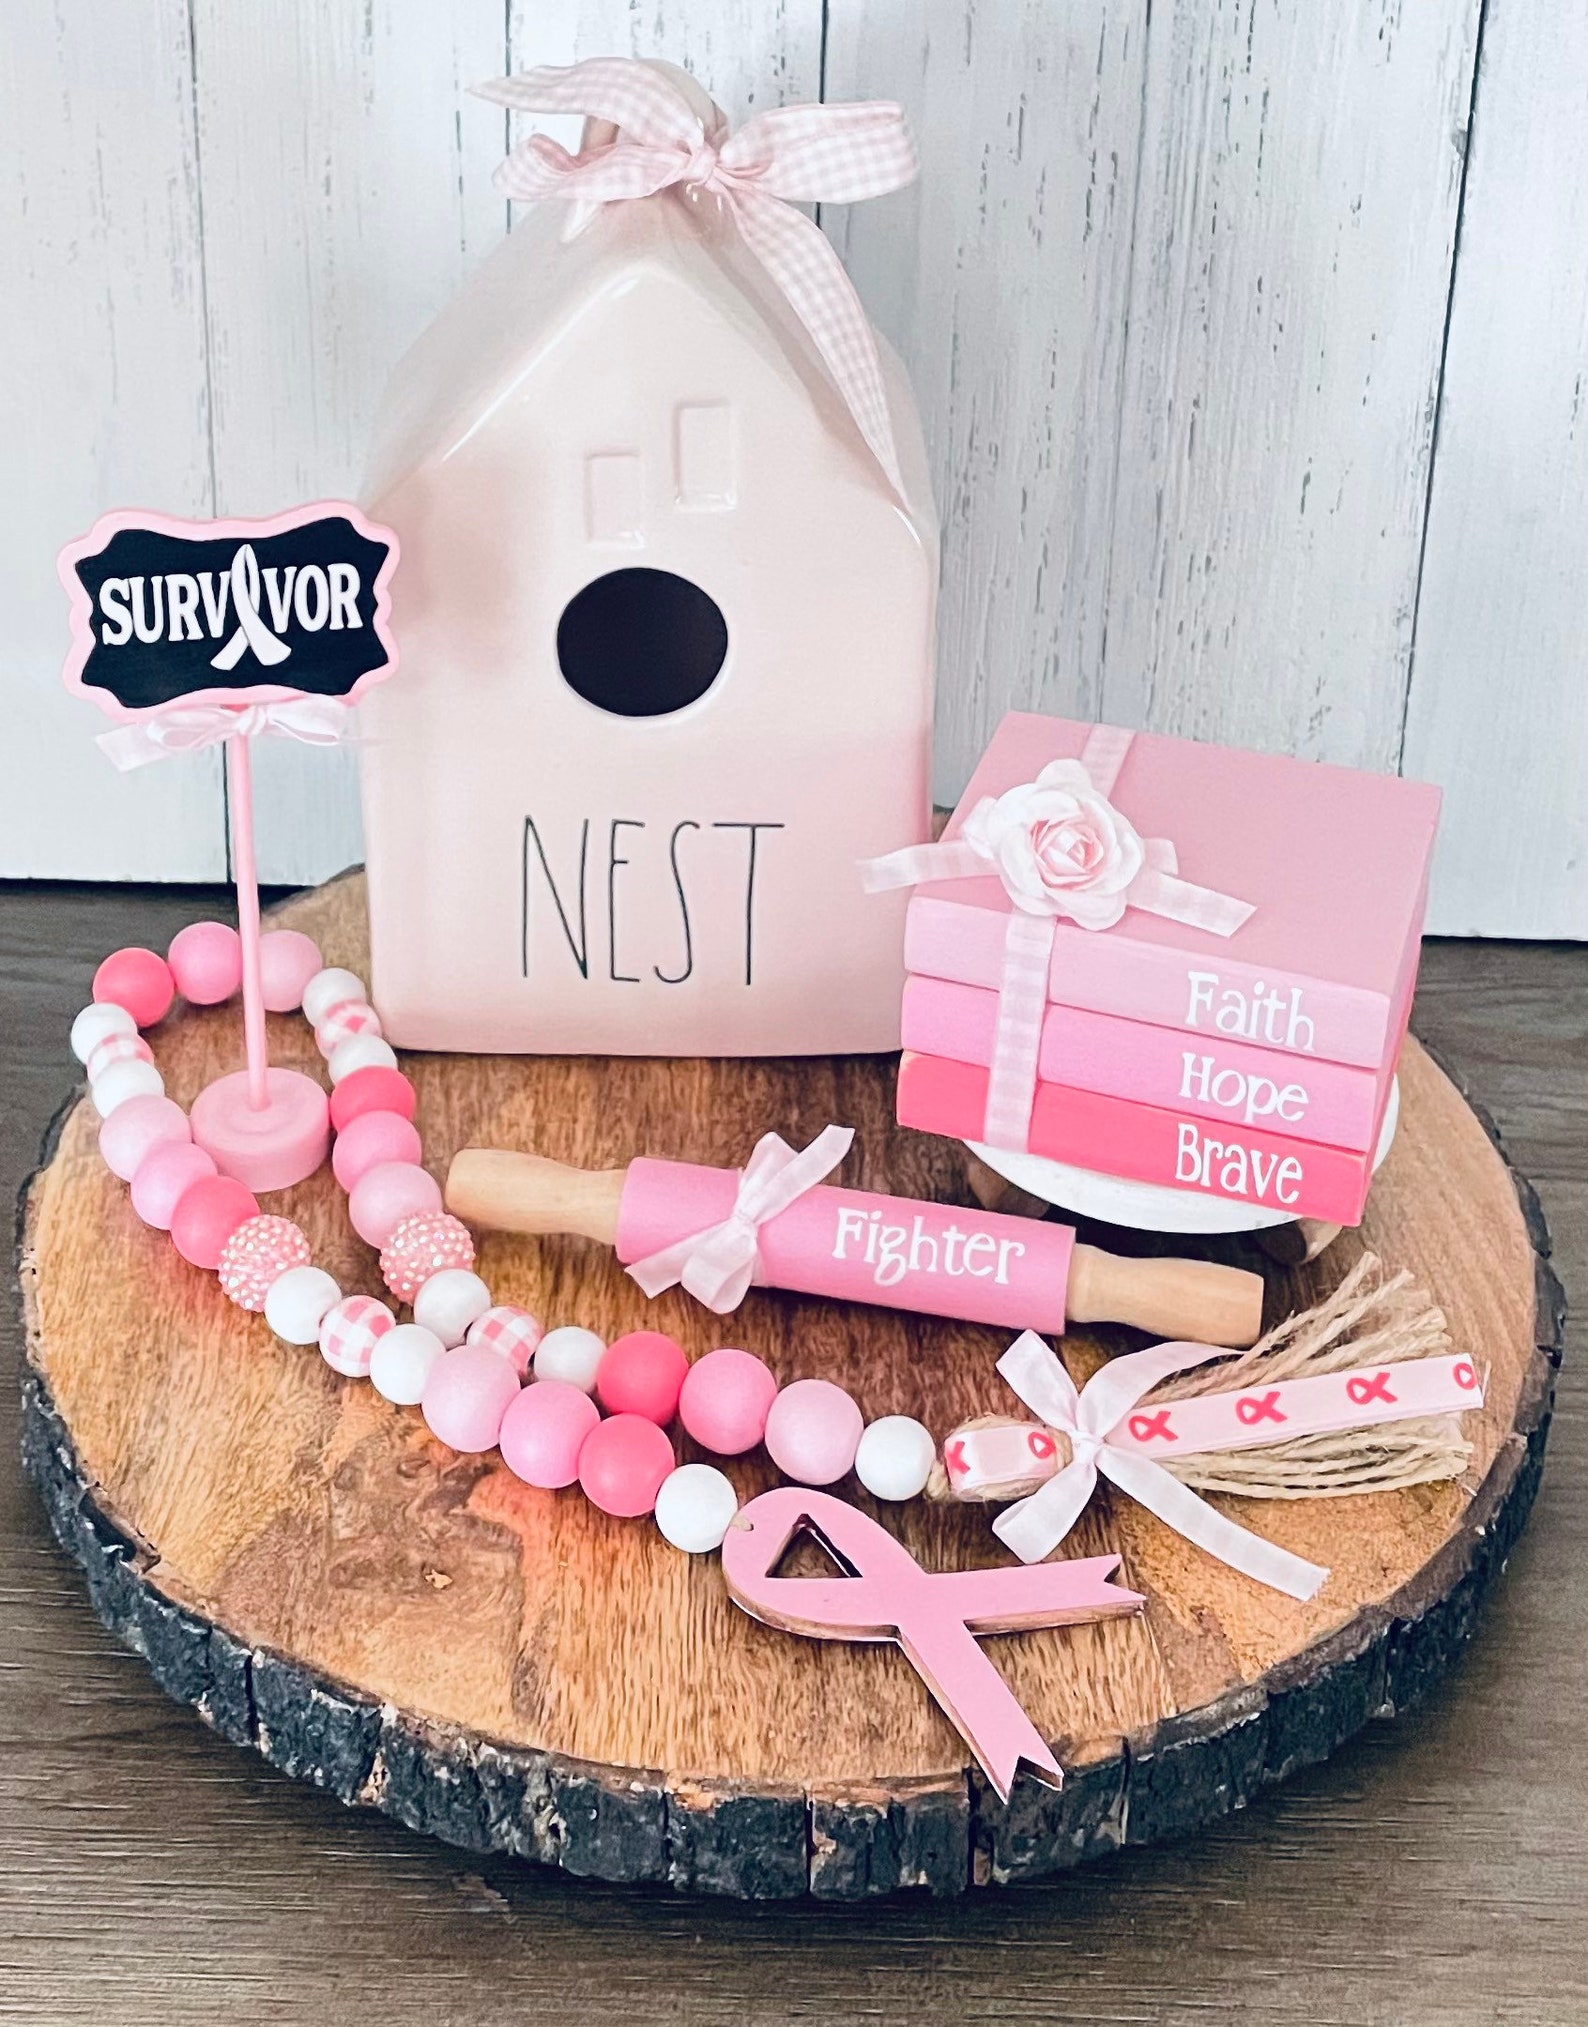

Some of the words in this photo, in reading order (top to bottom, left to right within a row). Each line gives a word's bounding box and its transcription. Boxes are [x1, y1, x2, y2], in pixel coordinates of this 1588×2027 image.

[100, 544, 363, 671] SURVIVOR
[523, 815, 785, 985] NEST
[1185, 970, 1315, 1051] Faith
[1178, 1052, 1309, 1123] Hope
[1175, 1122, 1303, 1204] Brave
[831, 1207, 1026, 1286] Fighter
